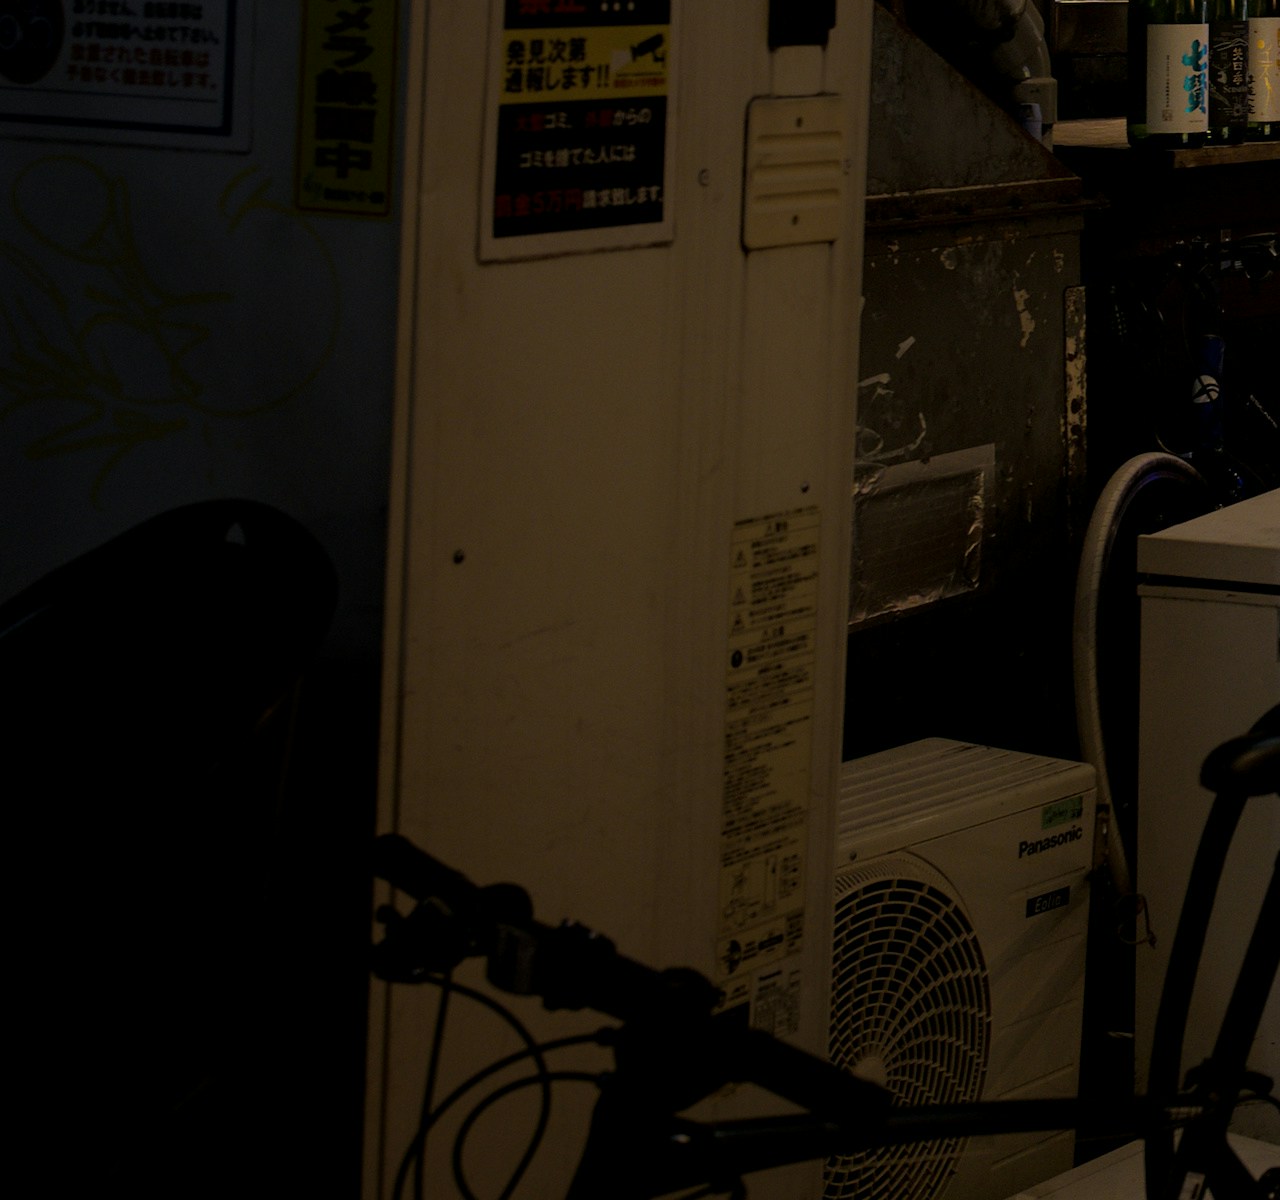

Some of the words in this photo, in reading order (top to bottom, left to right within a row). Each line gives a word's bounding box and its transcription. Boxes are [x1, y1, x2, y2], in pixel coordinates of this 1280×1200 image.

[507, 38, 586, 64] 発見次第
[1018, 824, 1083, 858] Panasonic
